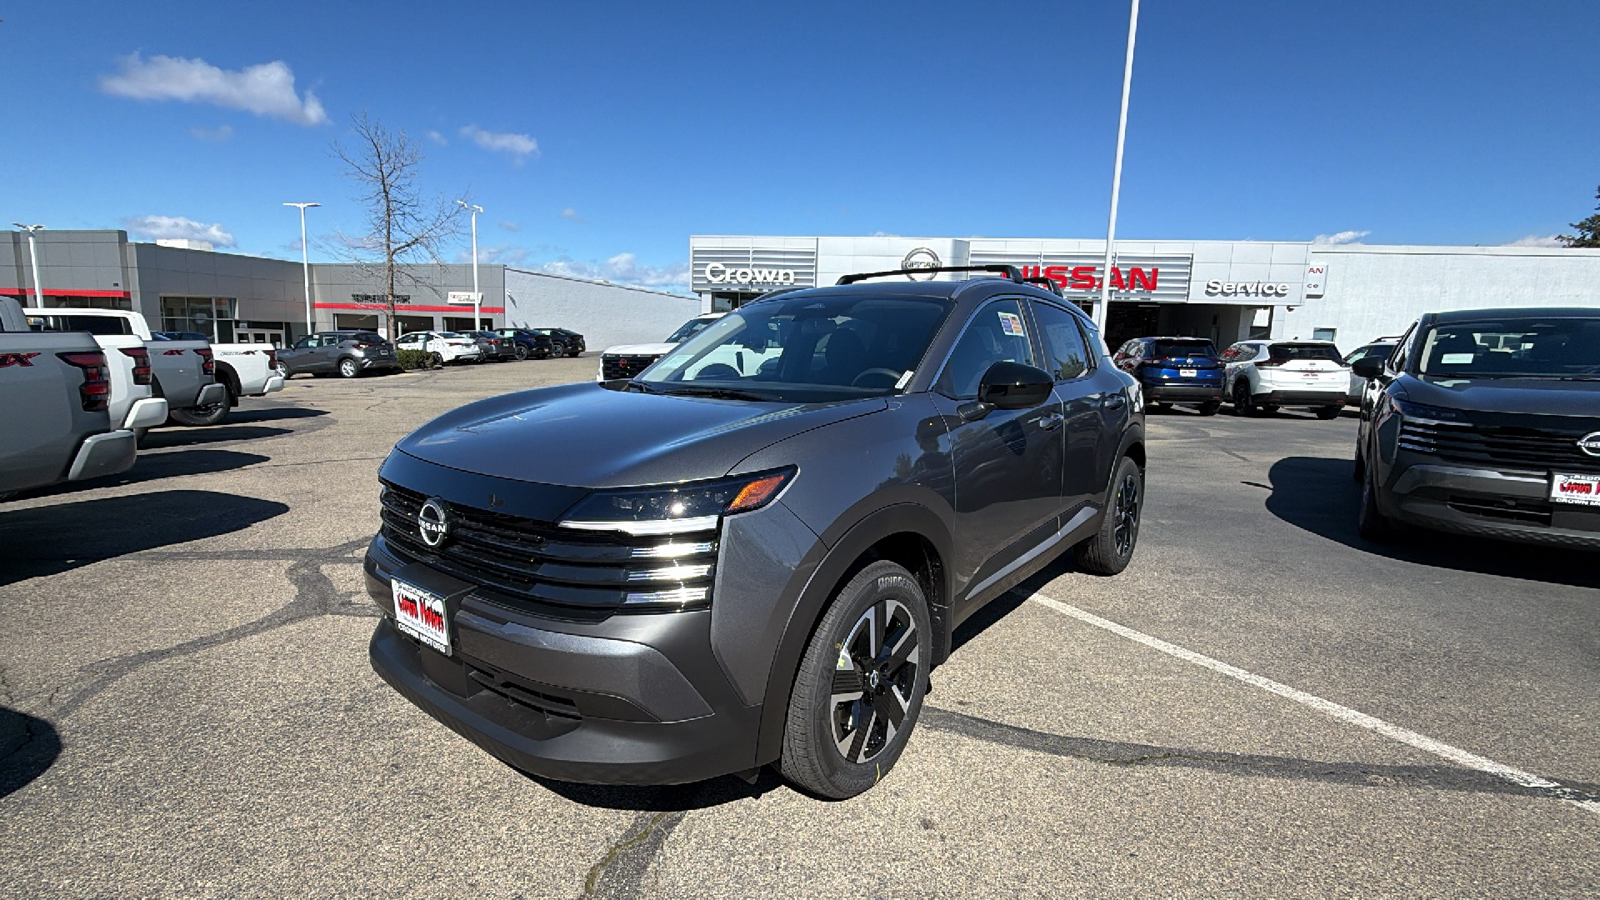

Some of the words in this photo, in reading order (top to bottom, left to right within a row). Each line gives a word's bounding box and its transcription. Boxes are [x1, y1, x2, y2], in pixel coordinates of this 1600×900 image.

[705, 262, 795, 283] Crown
[1206, 279, 1290, 295] Service
[418, 517, 446, 533] NISSAN
